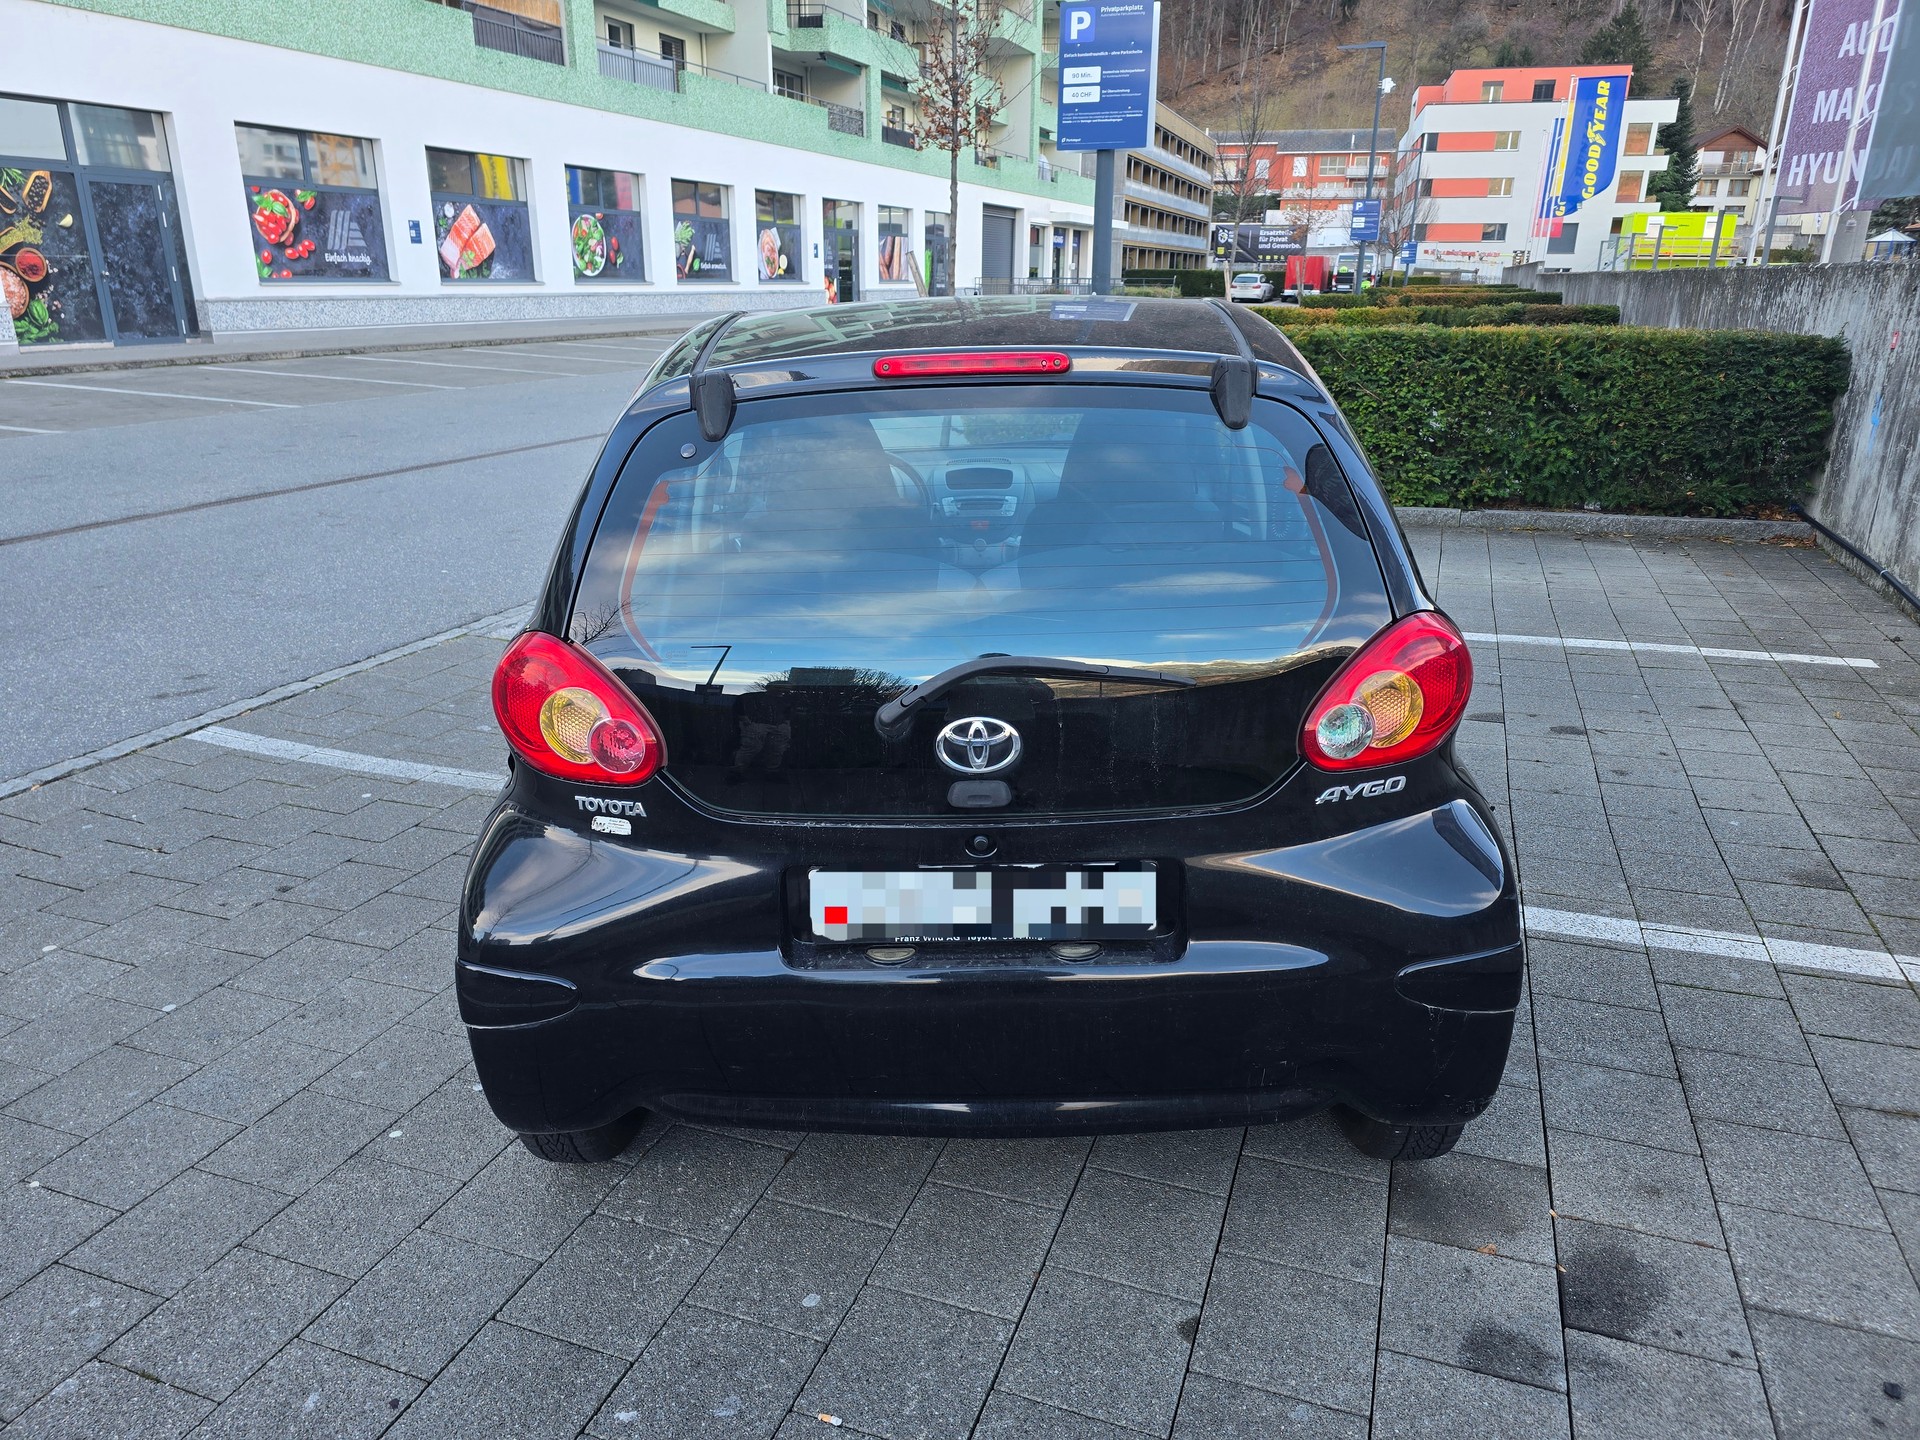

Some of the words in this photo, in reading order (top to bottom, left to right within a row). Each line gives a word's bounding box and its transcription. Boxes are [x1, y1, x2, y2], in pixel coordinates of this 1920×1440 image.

[1100, 4, 1144, 13] Privatparkplatz
[1070, 11, 1091, 40] P
[1581, 80, 1611, 199] GOODYEAR
[1355, 201, 1364, 211] P
[324, 252, 348, 264] Einfach
[1314, 775, 1407, 804] AYGO
[574, 795, 648, 818] TOYOTA
